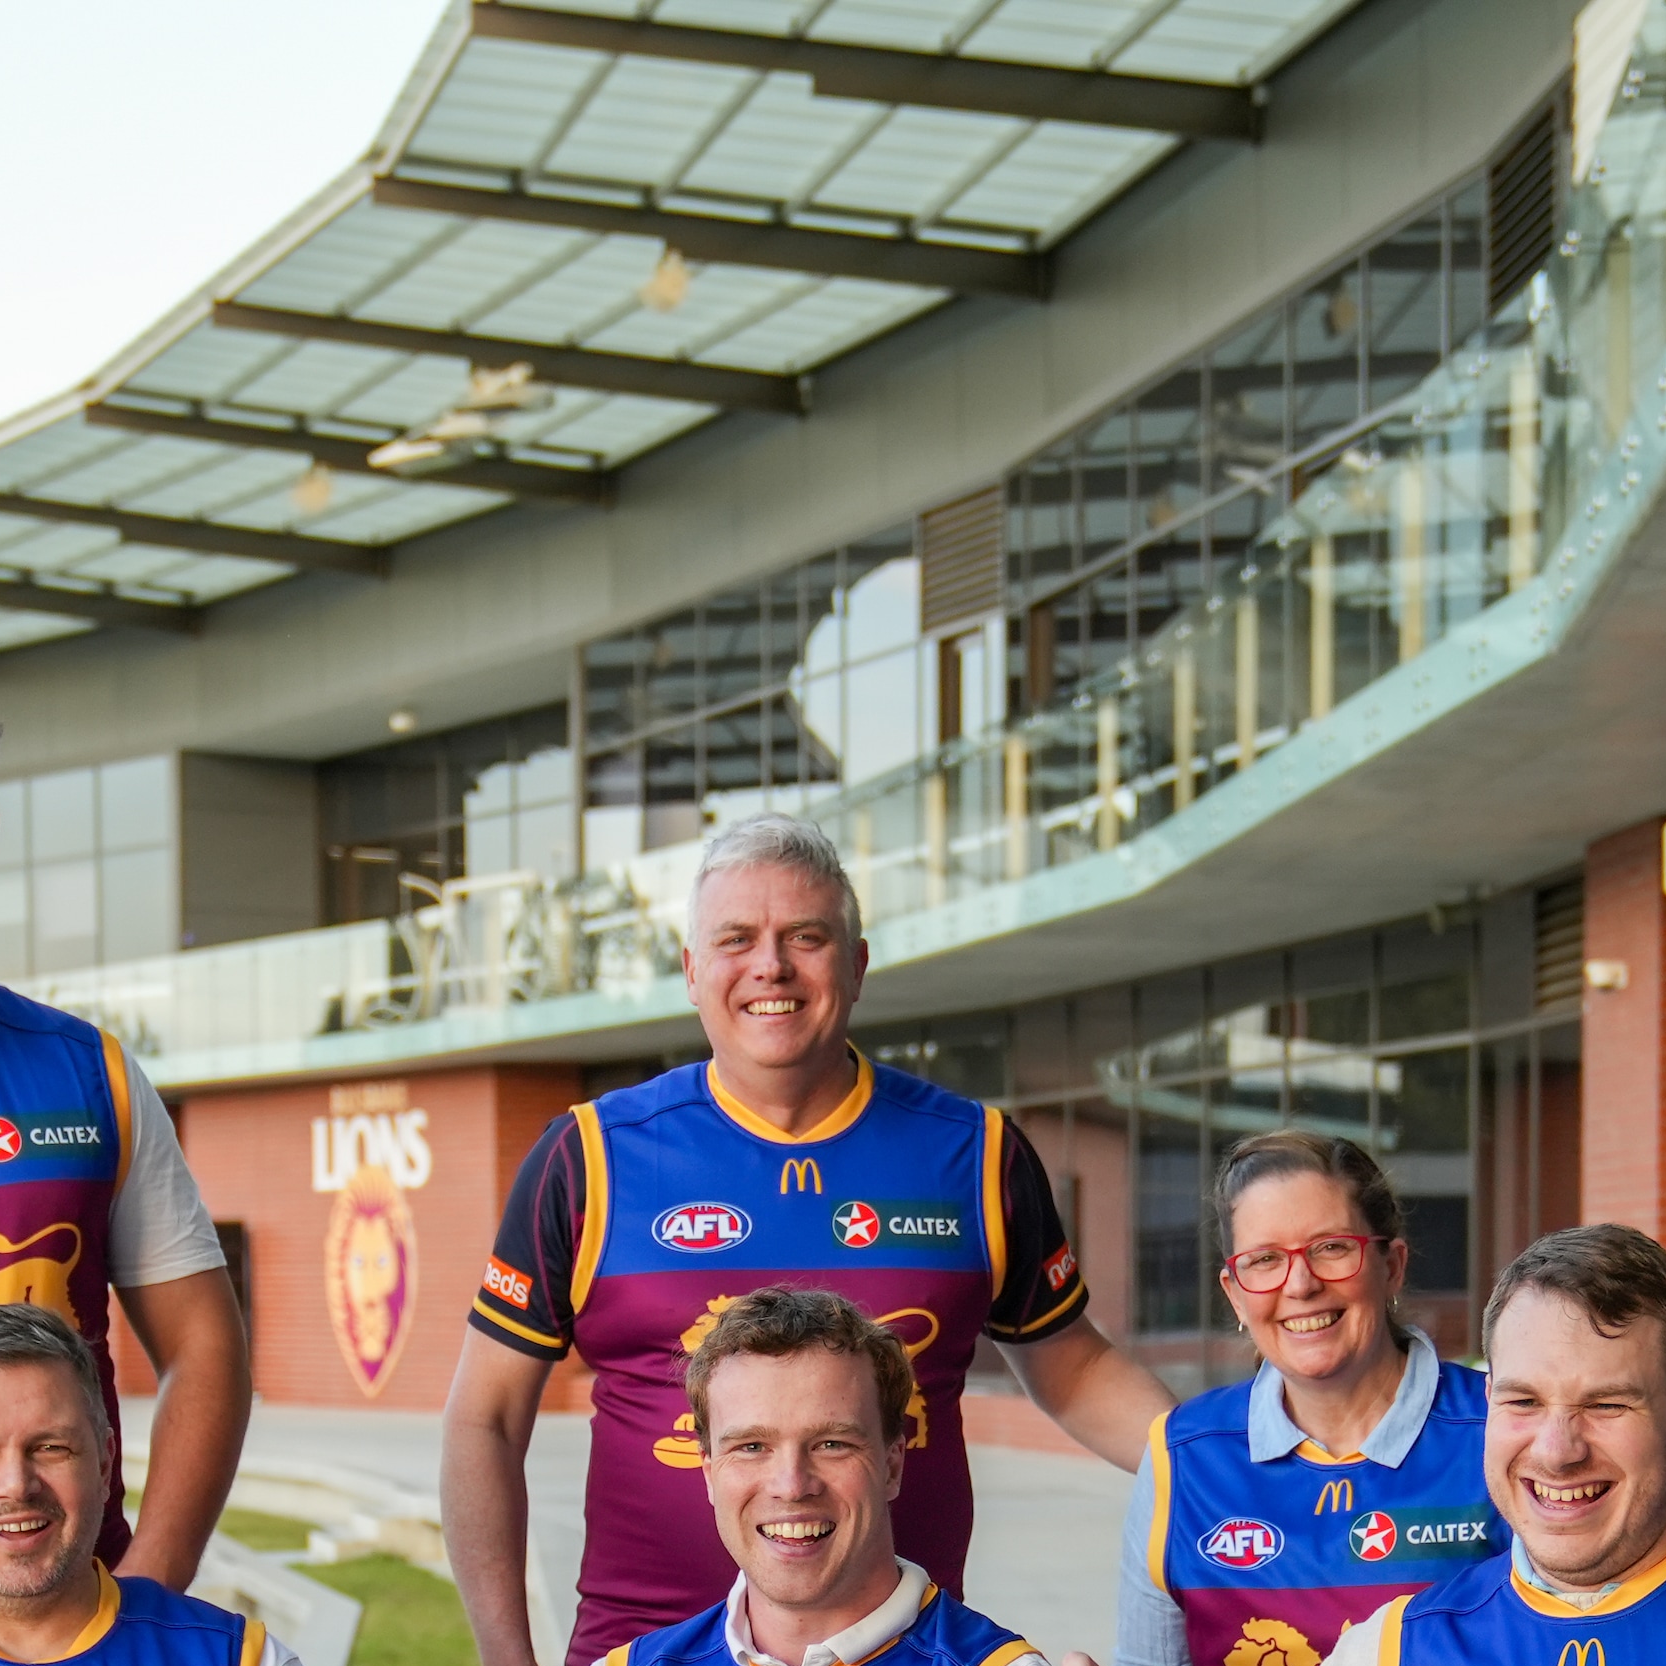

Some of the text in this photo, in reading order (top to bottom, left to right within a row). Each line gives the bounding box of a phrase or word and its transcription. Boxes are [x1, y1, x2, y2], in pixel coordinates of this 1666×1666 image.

[30, 1126, 101, 1147] CALTEX
[312, 1107, 432, 1192] LIONS
[661, 1214, 742, 1240] AFL
[889, 1217, 960, 1237] CALTEX
[1048, 1245, 1076, 1287] ne
[1205, 1528, 1275, 1557] AFL
[1406, 1521, 1487, 1545] CALTEX
